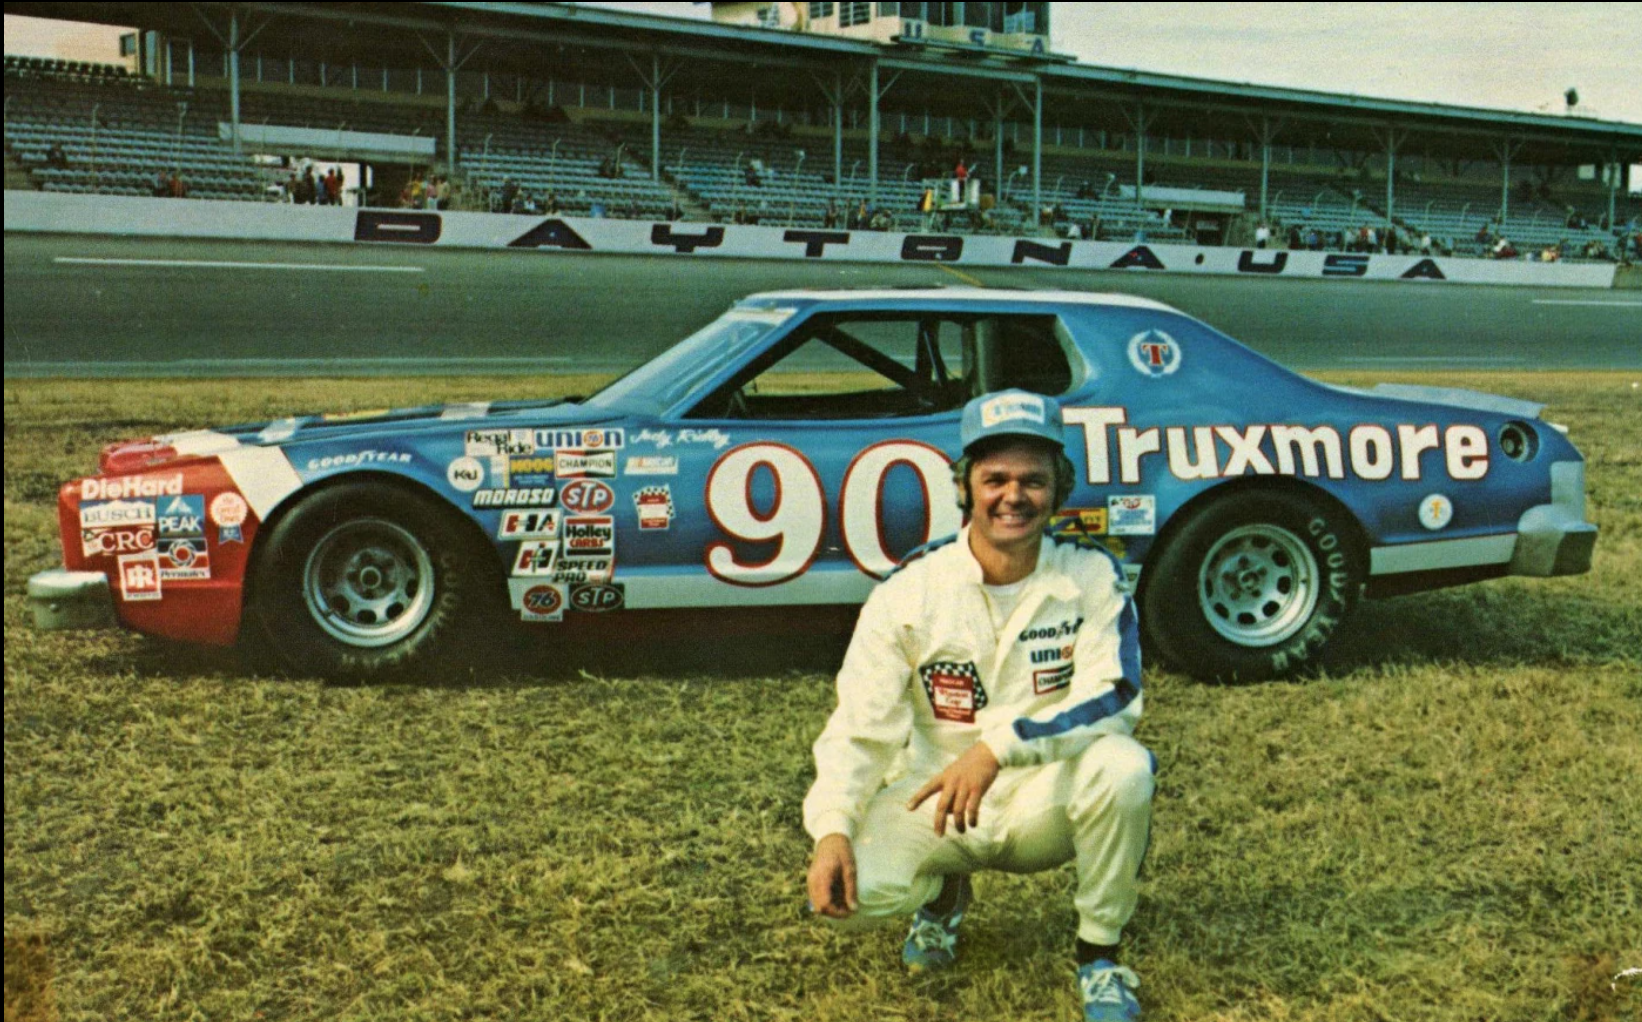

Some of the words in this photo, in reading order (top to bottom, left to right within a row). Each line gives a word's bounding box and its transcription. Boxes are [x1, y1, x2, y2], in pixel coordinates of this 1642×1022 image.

[1060, 405, 1490, 486] Truxmore
[308, 450, 412, 470] GOODYEAR
[558, 458, 613, 469] CHAMPION
[81, 473, 184, 500] DieHard
[567, 482, 608, 509] STP
[84, 507, 151, 523] BUSCH
[704, 438, 968, 588] 90
[158, 515, 203, 533] PEAK
[565, 525, 612, 541] Holley
[99, 530, 154, 553] CRC
[556, 560, 608, 571] SPEED
[528, 592, 558, 608] 76
[577, 587, 616, 606] STP
